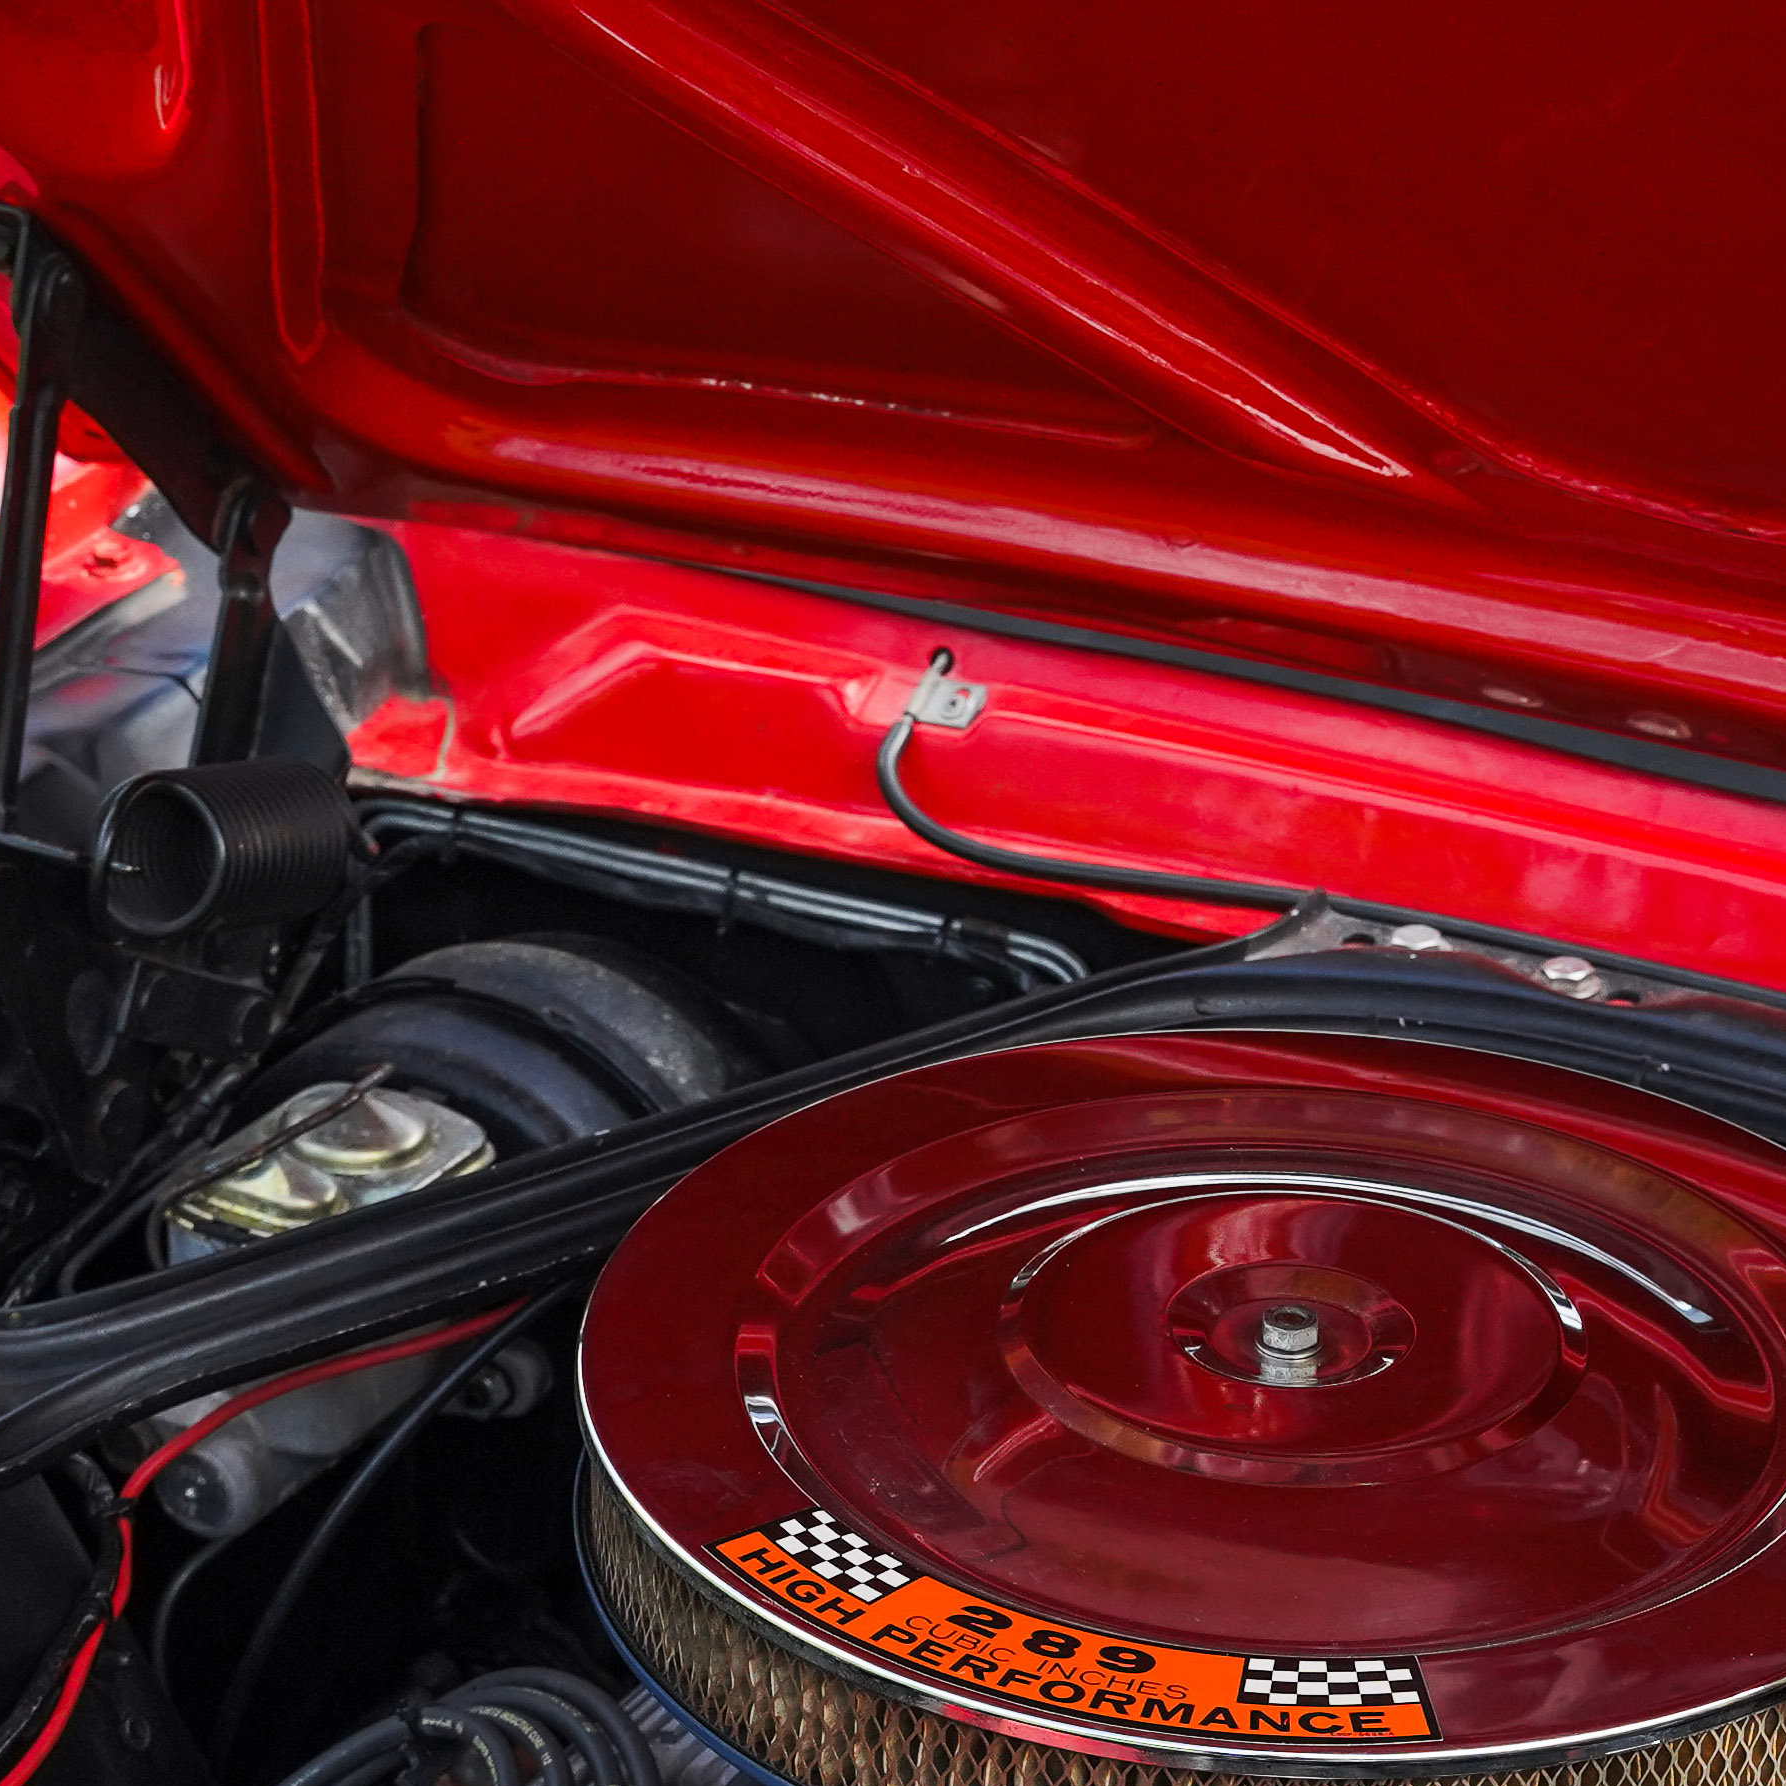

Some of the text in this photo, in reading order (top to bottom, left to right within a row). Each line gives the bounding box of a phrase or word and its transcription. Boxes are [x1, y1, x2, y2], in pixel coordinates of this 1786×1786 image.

[740, 1548, 1391, 1735] HIGH PERFORMANCE
[905, 1615, 1190, 1700] CUBIC INCHES
[946, 1606, 1156, 1674] 289
